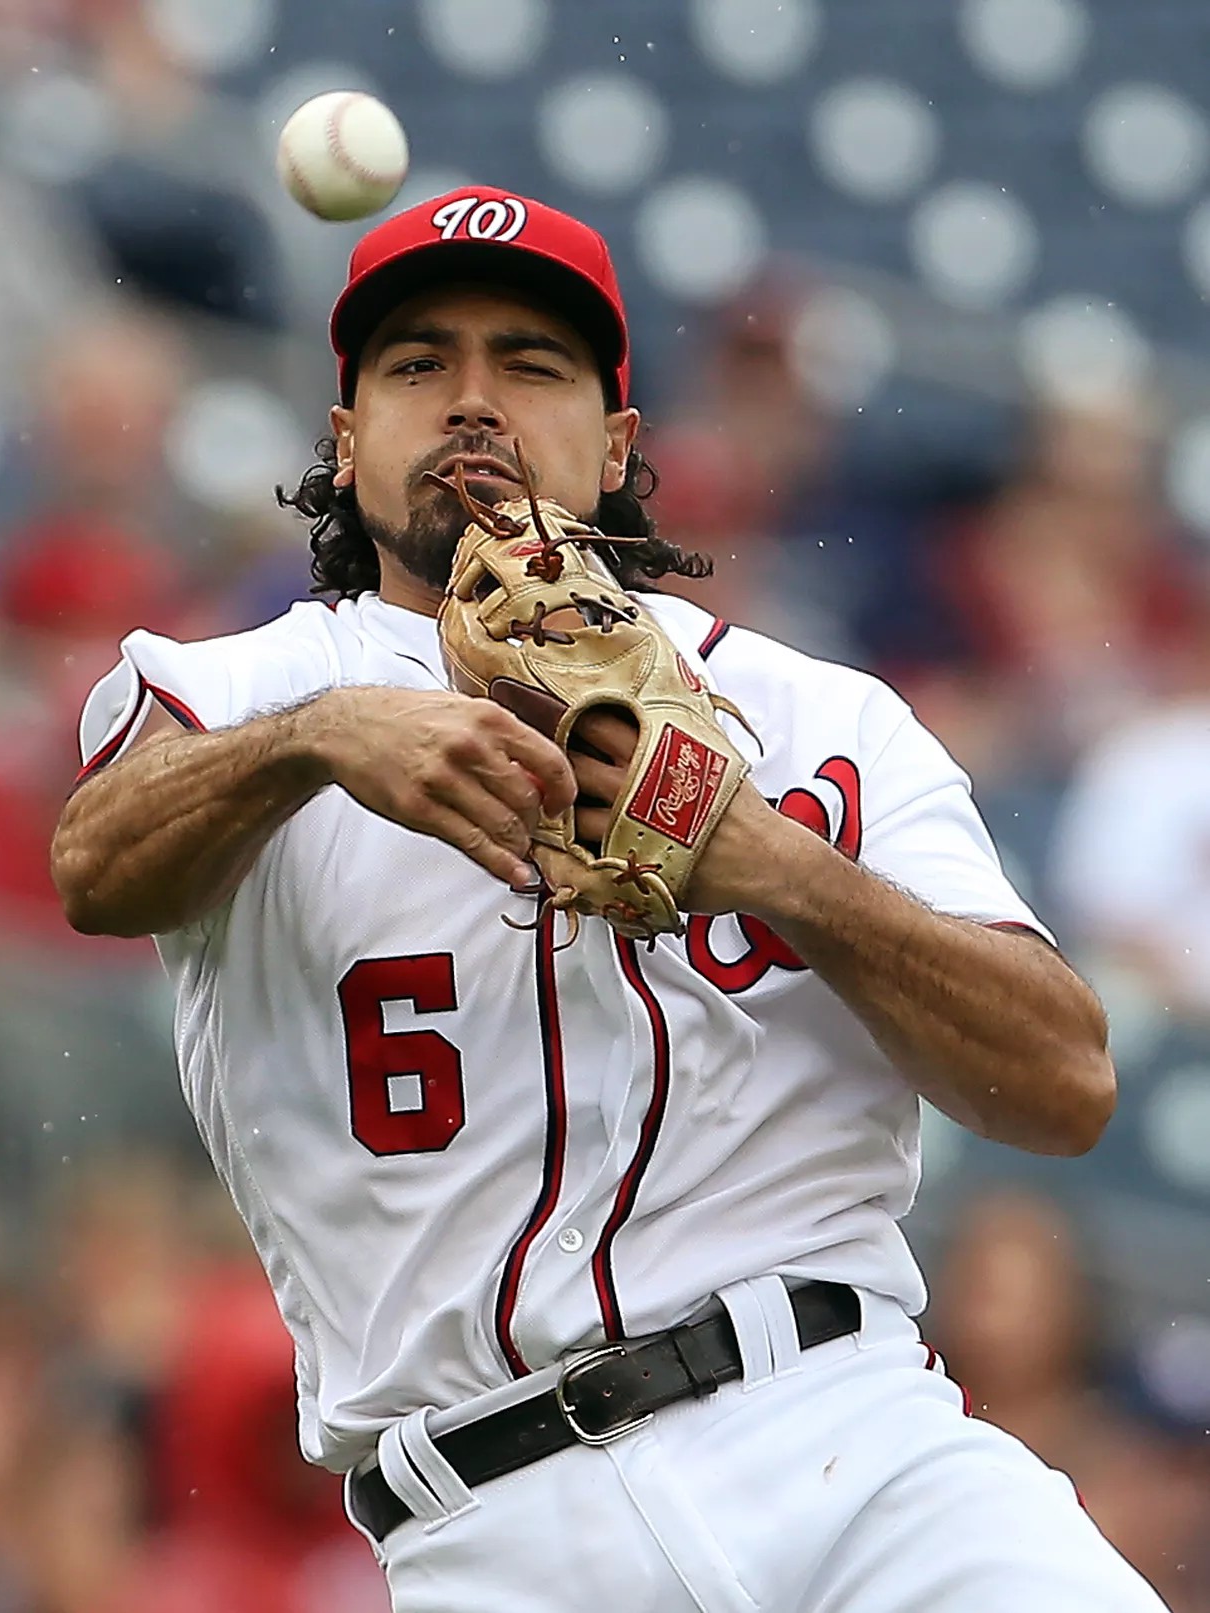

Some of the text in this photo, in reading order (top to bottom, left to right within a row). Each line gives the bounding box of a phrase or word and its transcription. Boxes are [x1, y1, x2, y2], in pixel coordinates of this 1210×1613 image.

[431, 196, 528, 242] W
[655, 742, 700, 826] Rawlings
[338, 952, 466, 1157] 6
